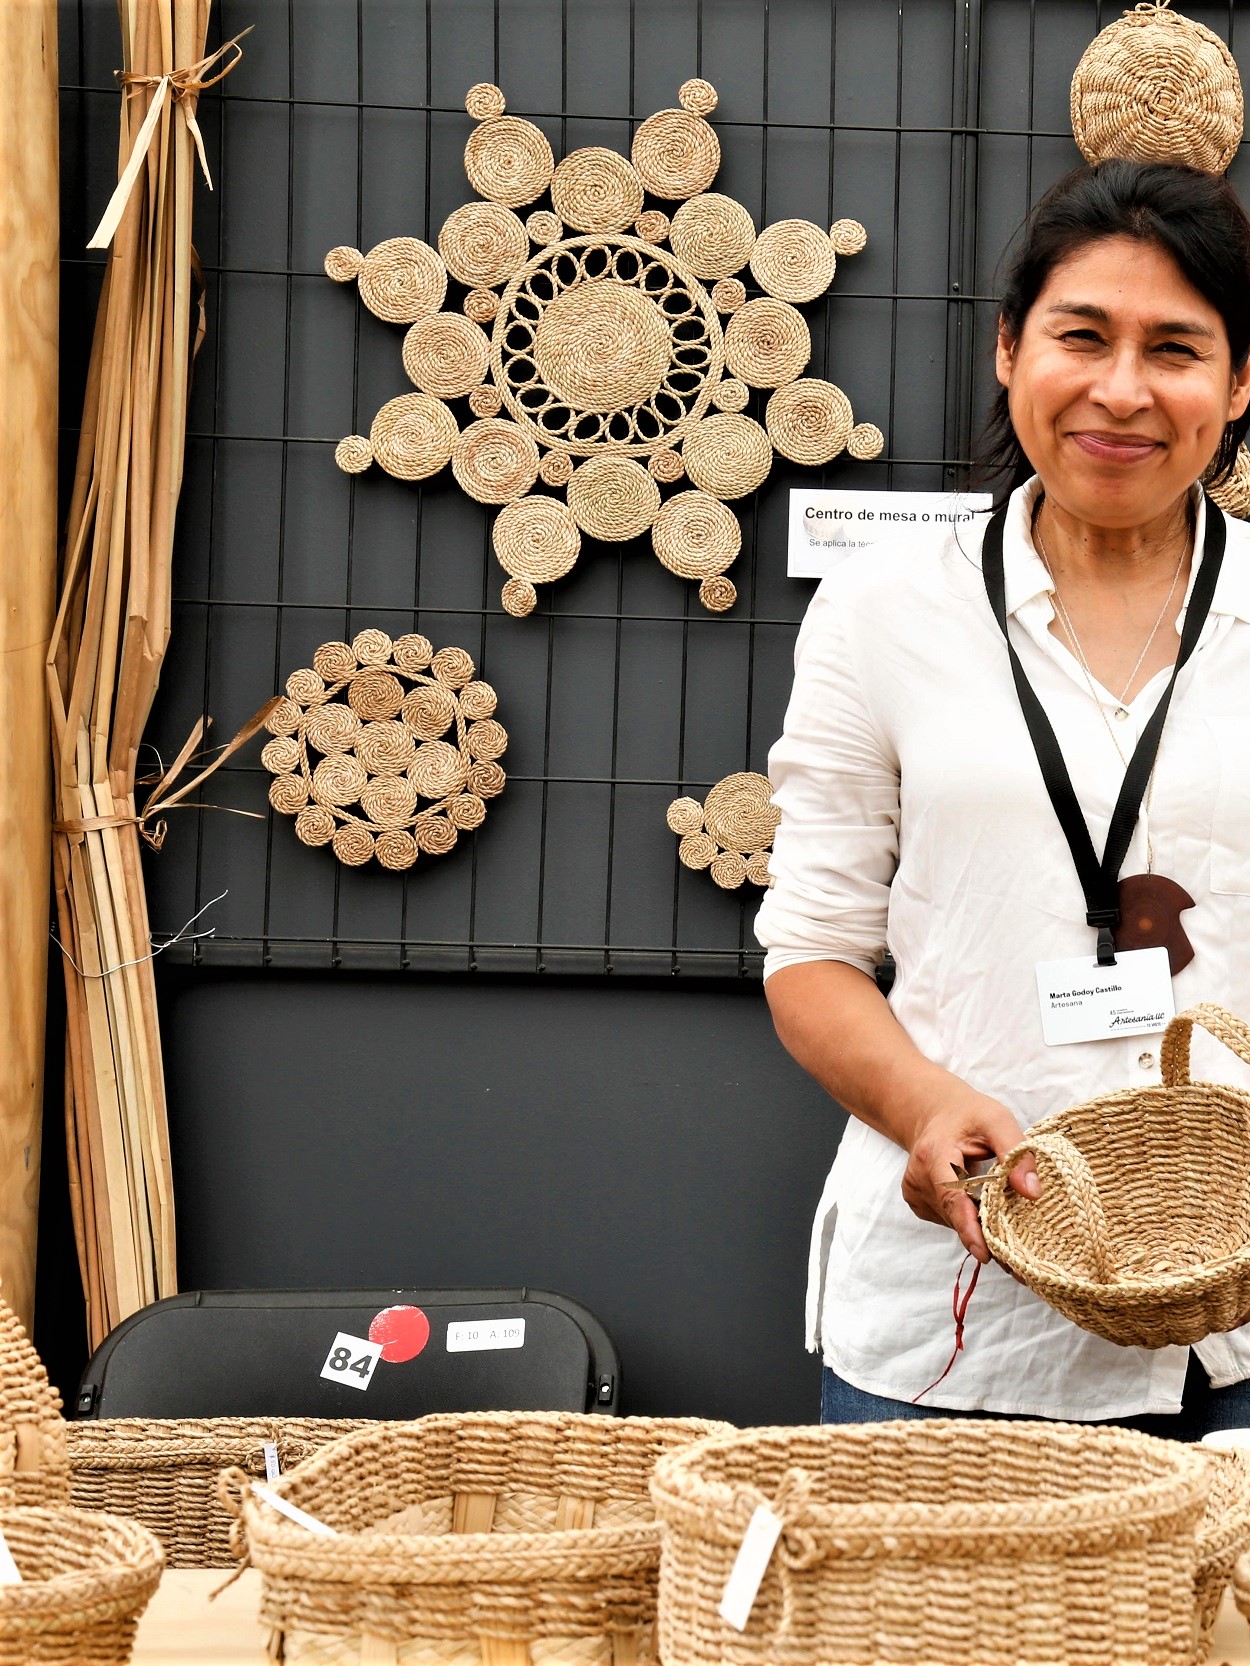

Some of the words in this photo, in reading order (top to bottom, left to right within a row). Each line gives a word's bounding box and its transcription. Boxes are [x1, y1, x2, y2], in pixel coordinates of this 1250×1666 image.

[805, 507, 853, 520] Centro
[858, 509, 875, 521] de
[879, 512, 917, 522] mesa
[921, 513, 930, 522] o
[809, 538, 821, 547] Se
[823, 540, 847, 548] aplica
[848, 540, 856, 548] la
[1049, 991, 1071, 1000] Marta
[1072, 988, 1094, 997] Godoy
[1095, 984, 1122, 994] Castillo
[1051, 1000, 1083, 1009] Artesana
[328, 1346, 373, 1379] 84
